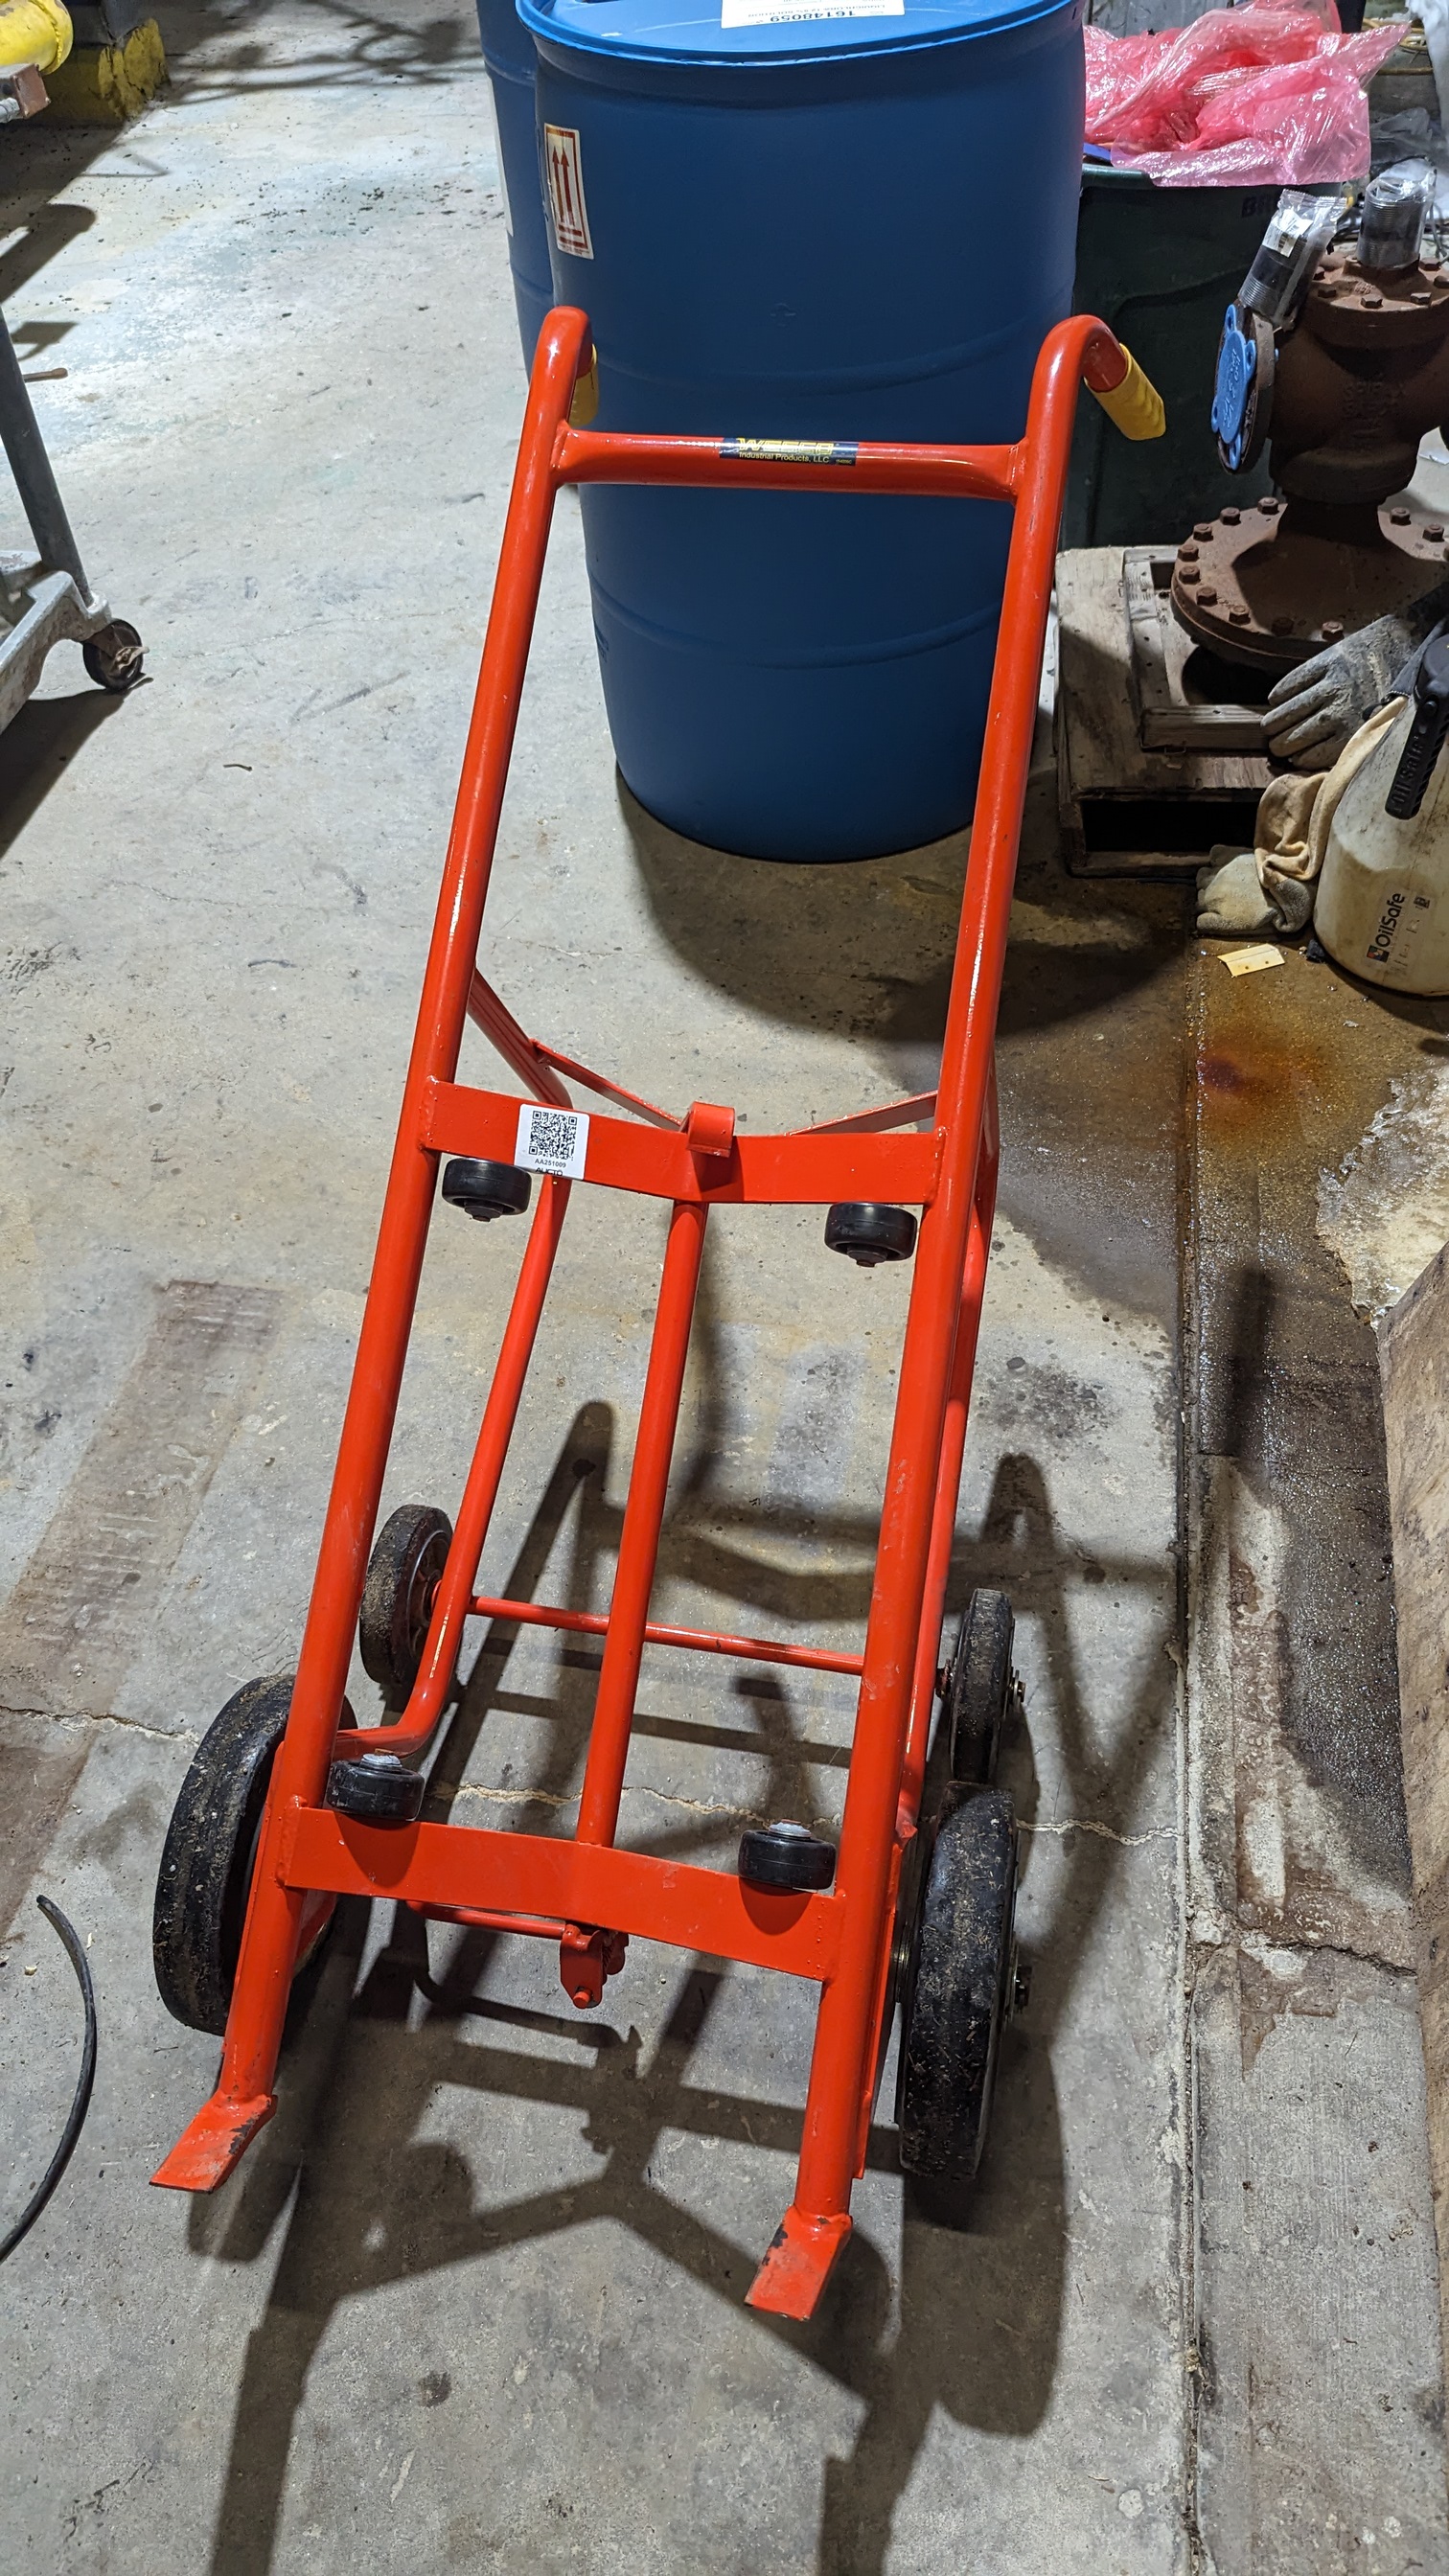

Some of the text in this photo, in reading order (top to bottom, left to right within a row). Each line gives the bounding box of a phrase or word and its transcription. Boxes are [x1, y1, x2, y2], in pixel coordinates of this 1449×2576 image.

[770, 11, 857, 22] 16148059
[739, 451, 774, 460] Industrial
[775, 453, 812, 463] Products,
[813, 455, 830, 464] LLC
[1374, 892, 1406, 948] OilSafe
[535, 1159, 566, 1168] AA251009
